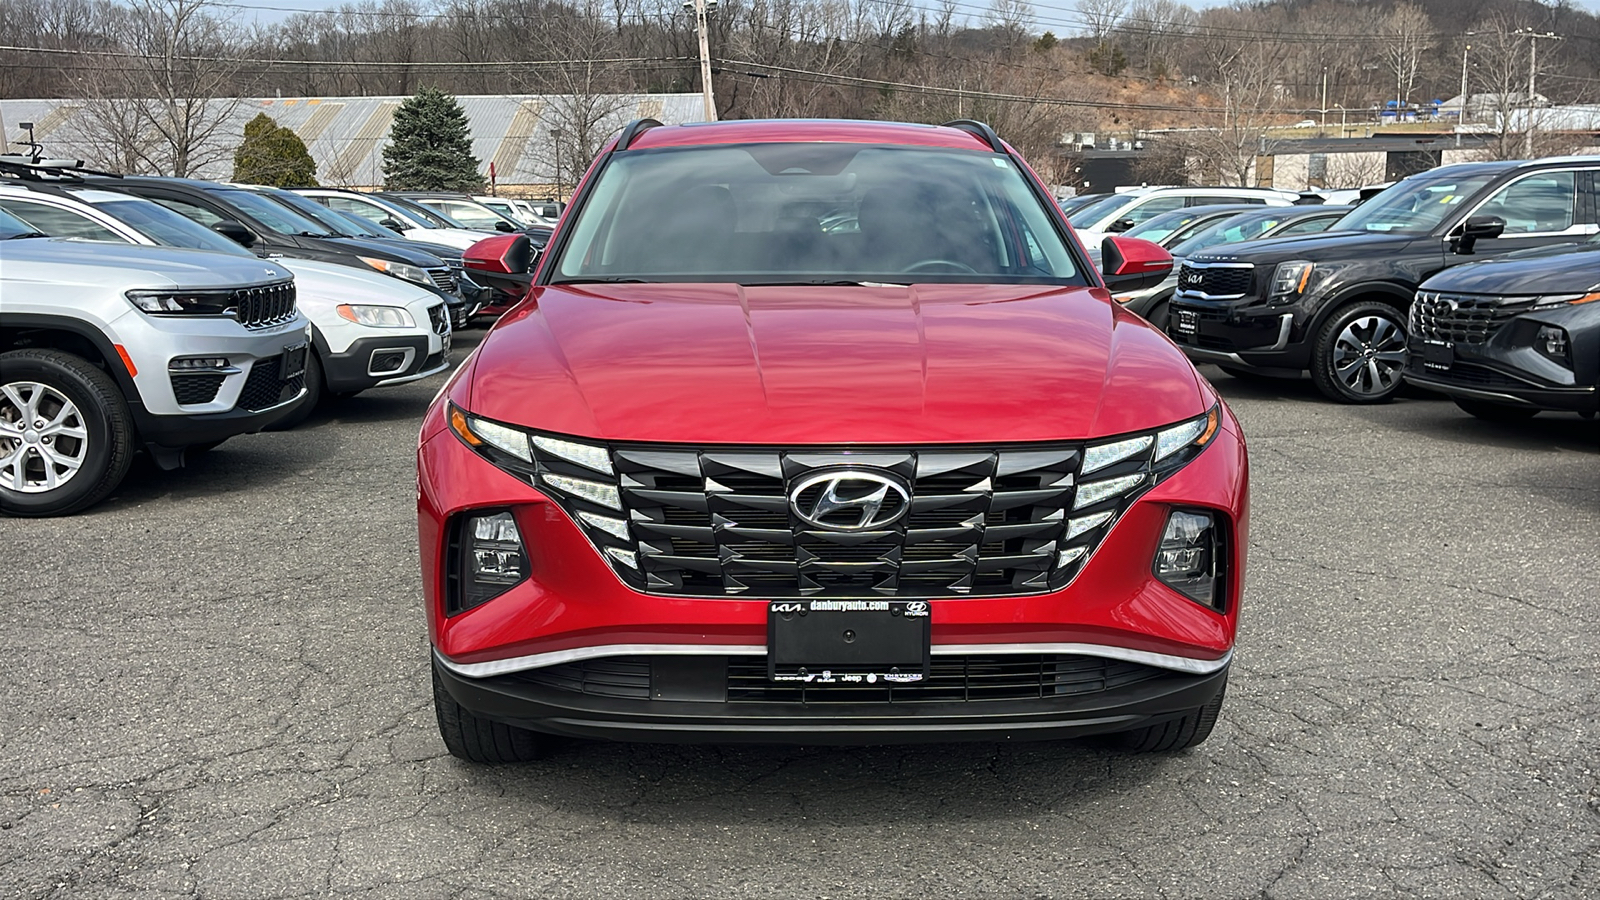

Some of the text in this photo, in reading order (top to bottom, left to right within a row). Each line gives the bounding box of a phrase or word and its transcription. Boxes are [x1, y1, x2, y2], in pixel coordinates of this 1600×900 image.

[1187, 274, 1203, 284] KIA
[771, 603, 802, 612] KIA
[810, 600, 889, 612] danburyauto.com
[841, 673, 862, 683] Jeep
